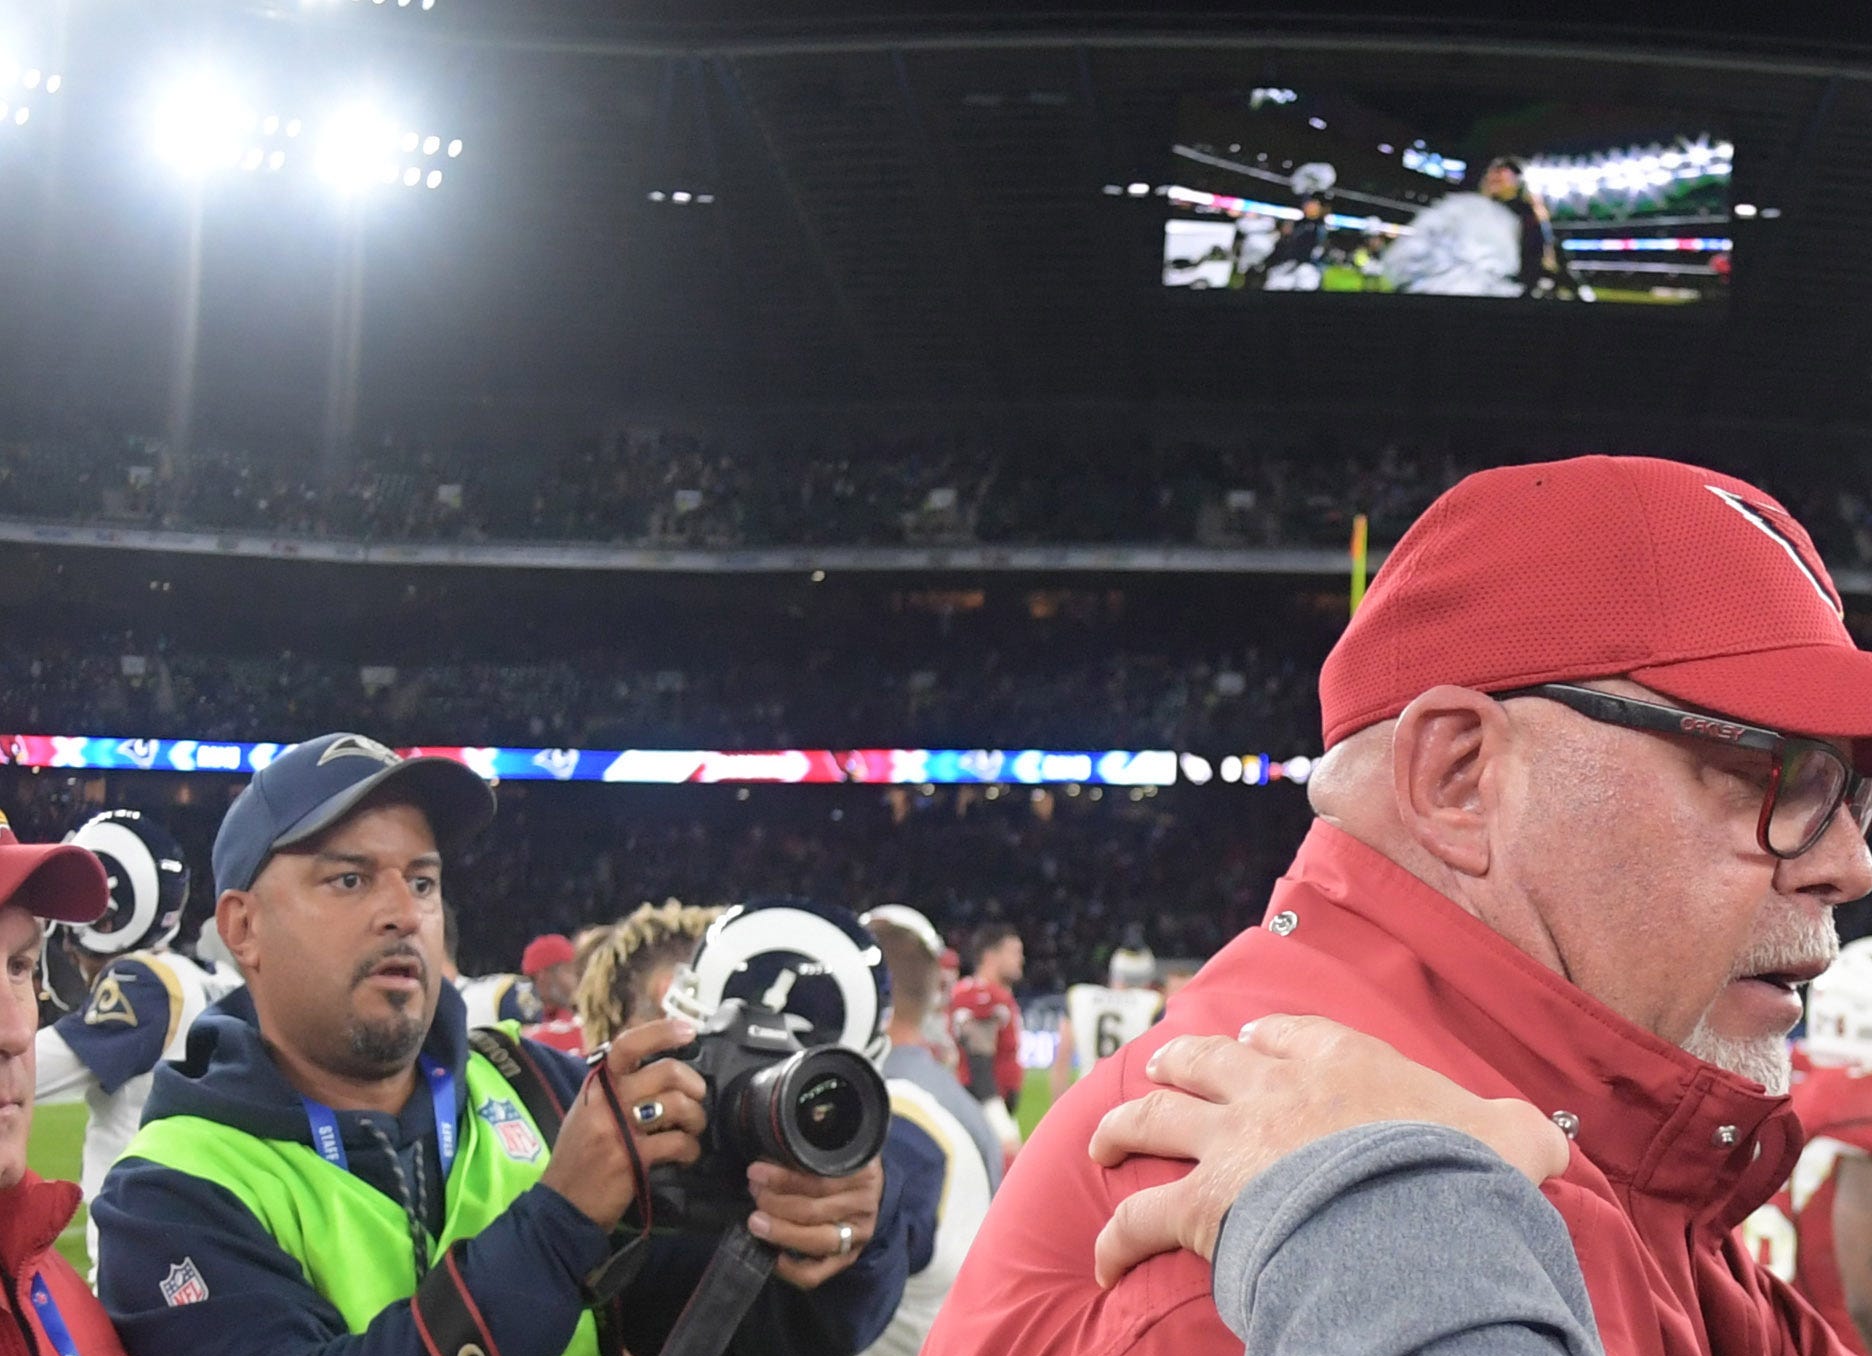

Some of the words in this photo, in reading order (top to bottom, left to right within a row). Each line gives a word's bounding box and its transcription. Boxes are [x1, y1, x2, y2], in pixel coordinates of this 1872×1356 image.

[1681, 716, 1745, 741] OAKLEY
[318, 1125, 340, 1161] STAFF
[441, 1121, 454, 1158] STAFF
